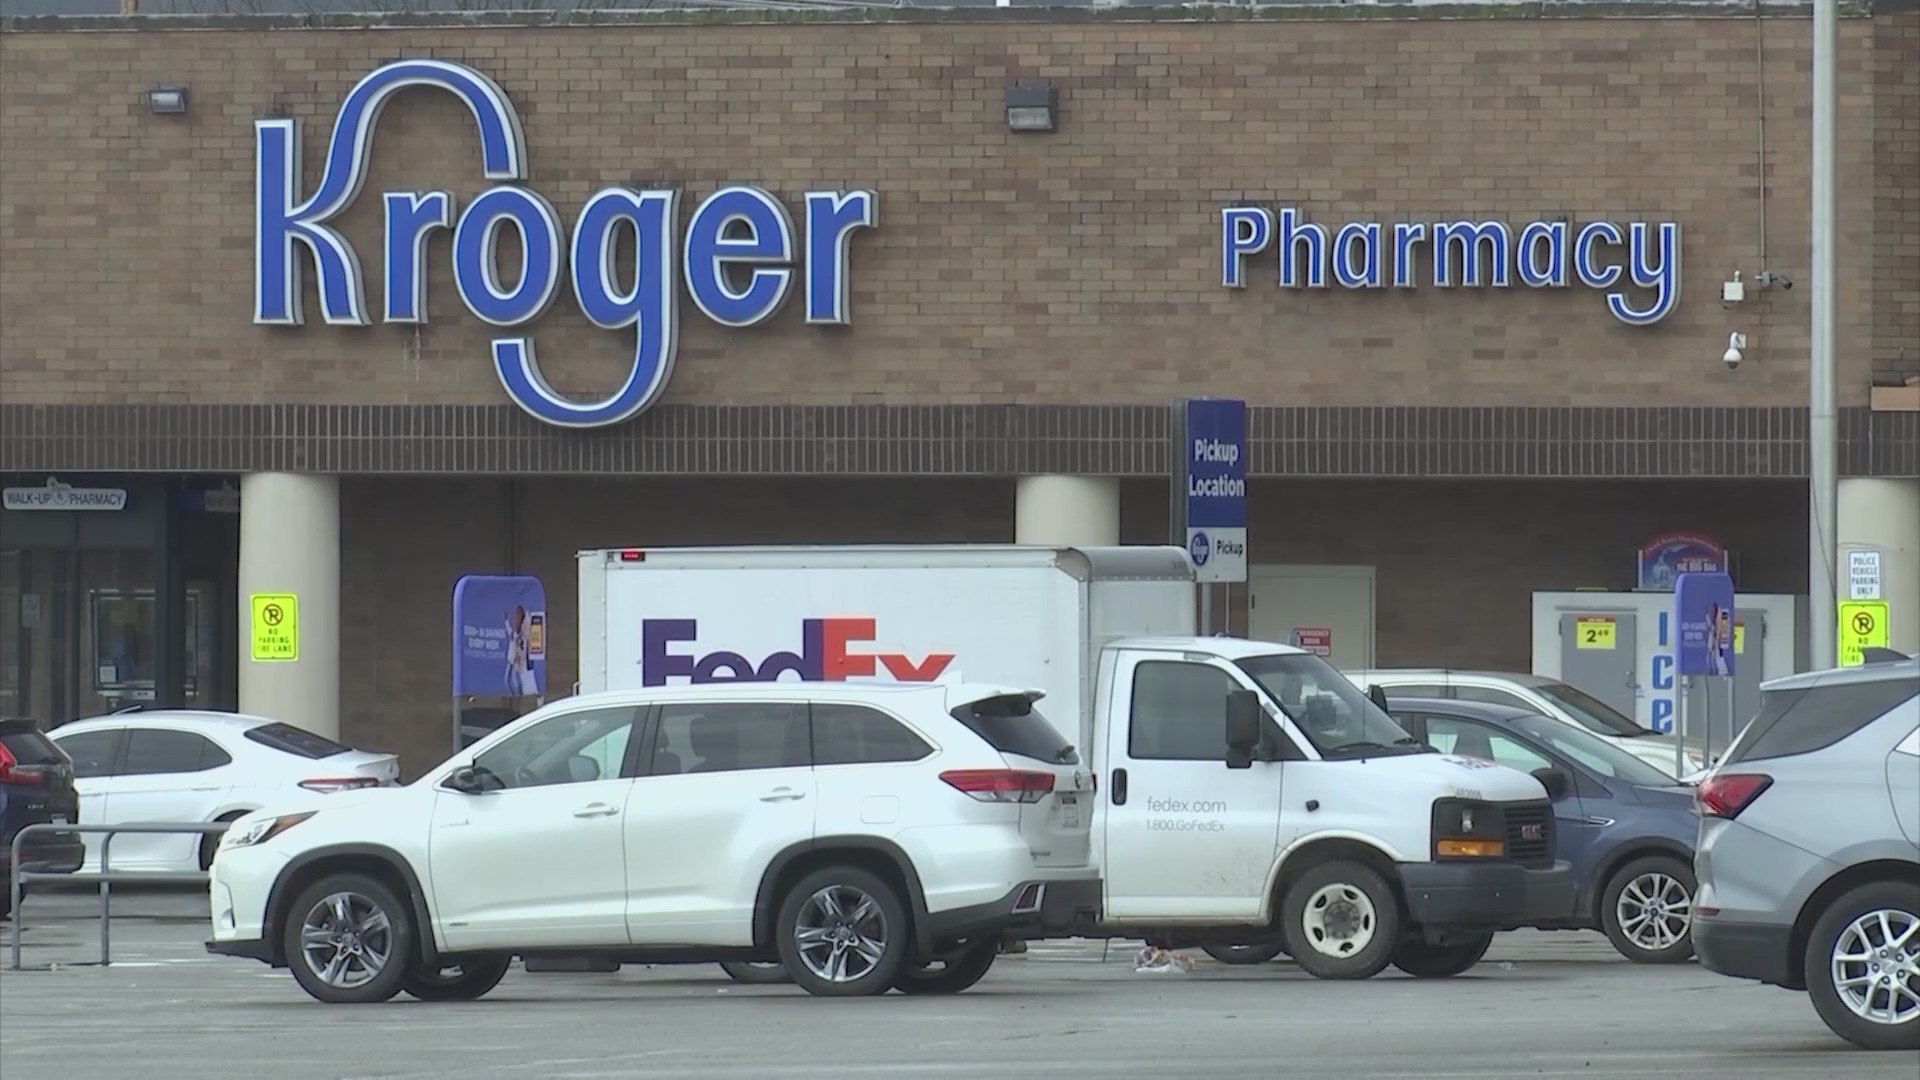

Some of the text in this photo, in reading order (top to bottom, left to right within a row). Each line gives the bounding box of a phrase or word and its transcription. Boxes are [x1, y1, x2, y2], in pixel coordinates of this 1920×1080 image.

[253, 59, 879, 428] Kroger
[1221, 206, 1683, 325] Pharmacy
[1194, 438, 1240, 467] Pickup
[1188, 473, 1246, 498] Location
[7, 492, 123, 506] WALK-UP PHARMACY
[1216, 540, 1244, 559] Pickup
[1853, 556, 1876, 566] POLICE
[1852, 566, 1878, 576] VEHICLE
[1851, 576, 1879, 585] PARKING
[1857, 586, 1874, 595] ONLY
[268, 627, 279, 636] NO
[258, 636, 290, 644] PARKING
[1857, 637, 1870, 645] NO
[273, 645, 293, 653] LANE
[1146, 795, 1228, 813] fedex.com
[1145, 818, 1226, 833] 1.800.GoFedEx
